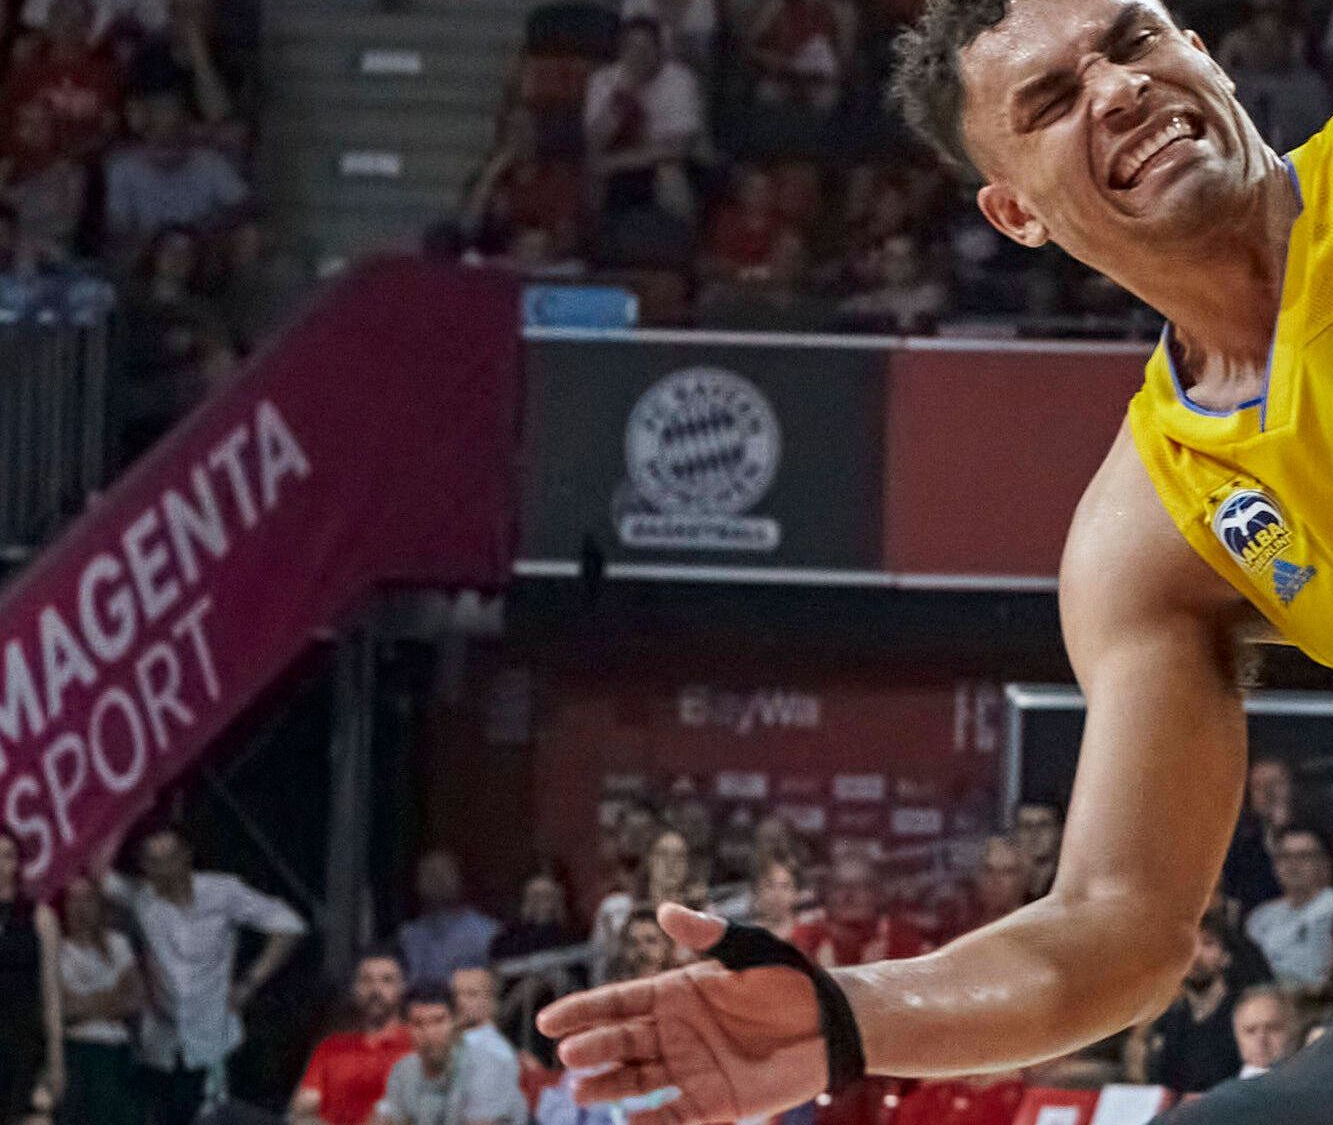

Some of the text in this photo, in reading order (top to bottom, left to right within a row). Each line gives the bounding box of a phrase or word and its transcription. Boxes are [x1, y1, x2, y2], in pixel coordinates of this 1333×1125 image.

[0, 399, 312, 769] MAGENTA
[1241, 522, 1290, 563] ALBA
[5, 594, 222, 877] SPORT
